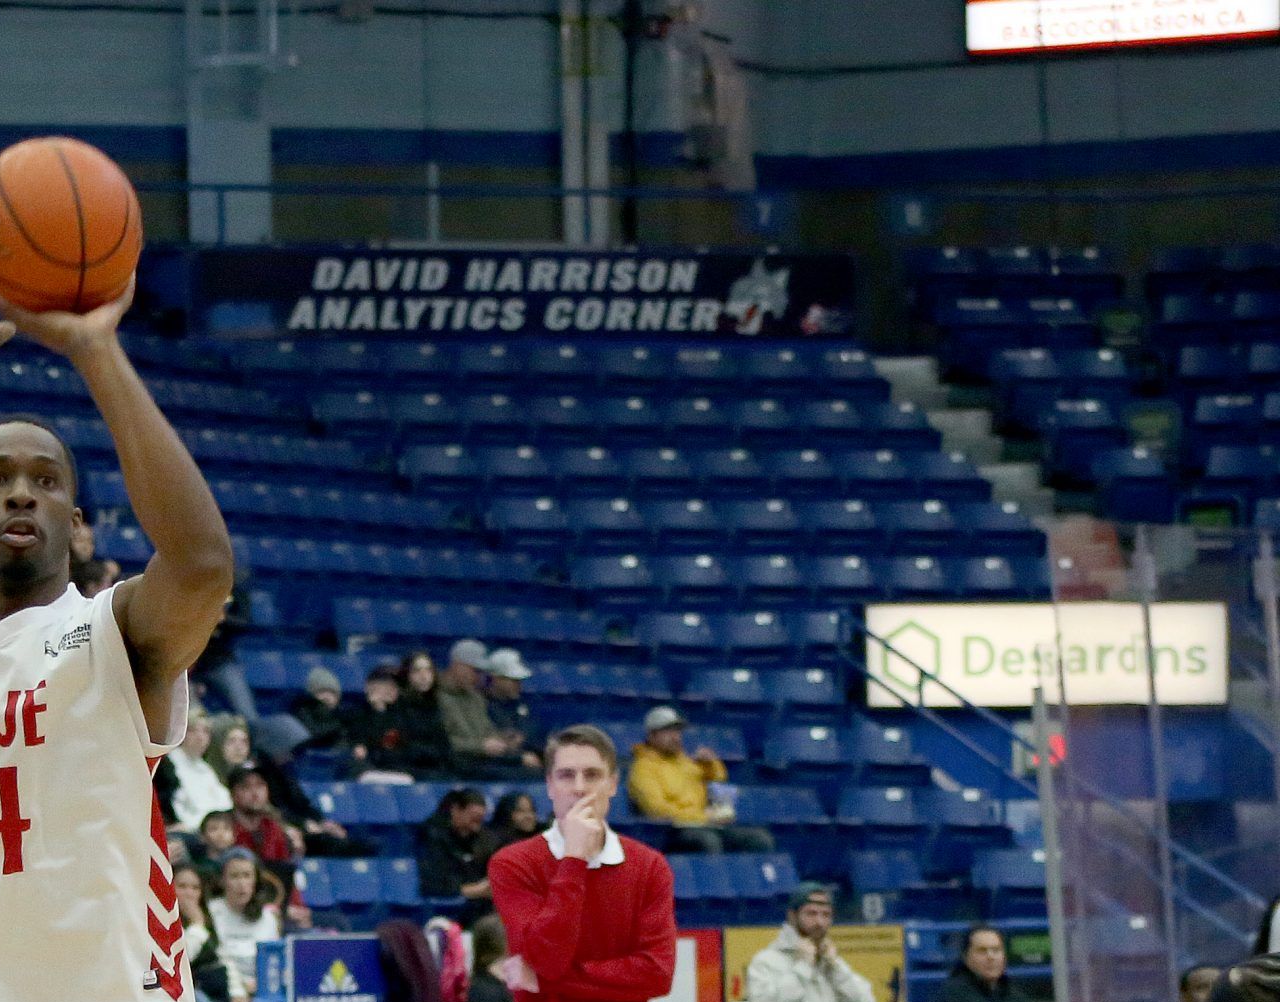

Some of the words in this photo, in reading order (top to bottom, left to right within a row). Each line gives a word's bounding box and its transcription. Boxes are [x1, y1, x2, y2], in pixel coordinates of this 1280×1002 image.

[312, 259, 449, 292] DAVID
[464, 259, 699, 292] HARRISON
[288, 298, 527, 331] ANALYTICS
[543, 298, 722, 331] CORNER
